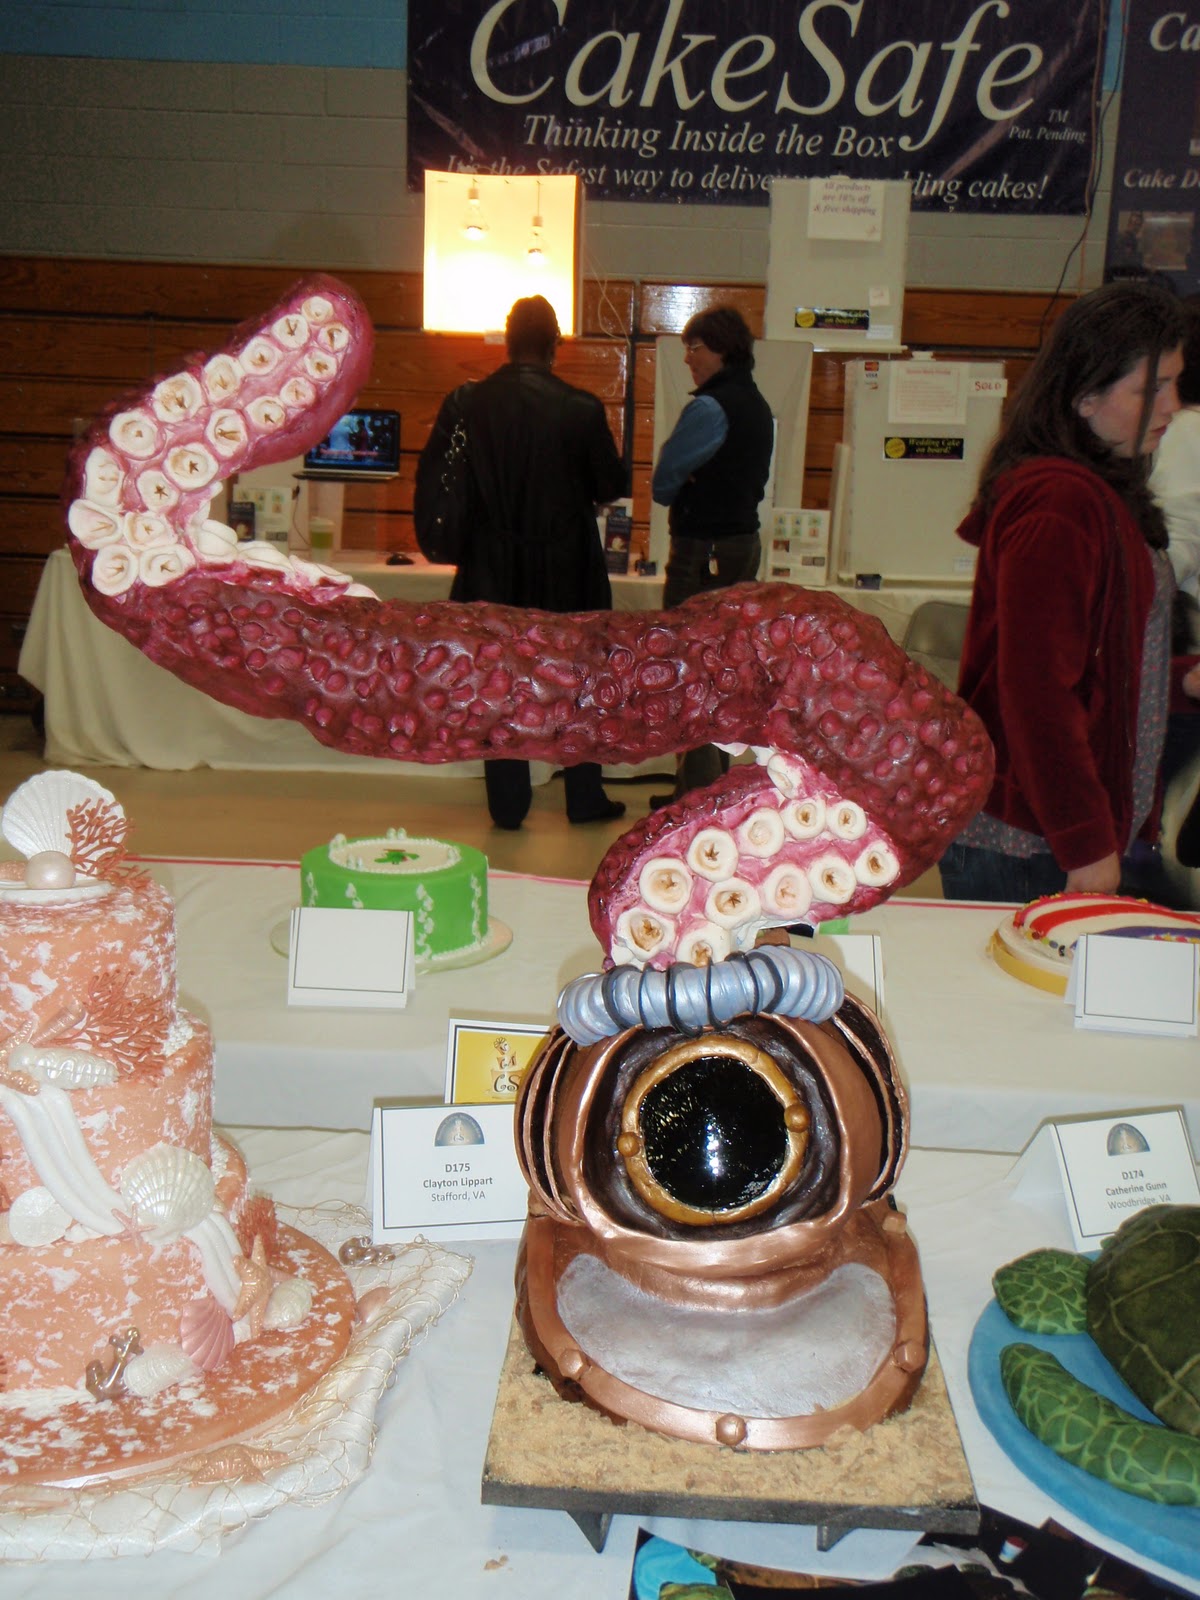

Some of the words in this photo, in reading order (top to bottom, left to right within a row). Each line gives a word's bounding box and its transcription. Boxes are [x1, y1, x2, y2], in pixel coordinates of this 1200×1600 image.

[470, 0, 1043, 151] CakeSafe
[524, 114, 661, 157] Thinking
[669, 120, 766, 153] Inside
[776, 124, 821, 156] the
[831, 126, 894, 158] Box
[1008, 125, 1033, 141] Pat.
[1036, 126, 1087, 143] Pending
[615, 166, 662, 192] way
[671, 168, 693, 189] to
[968, 174, 1050, 200] cakes!
[1123, 167, 1177, 189] Cake
[1179, 169, 1200, 189] D
[444, 1162, 471, 1174] D175
[1121, 1169, 1144, 1181] D174
[422, 1179, 458, 1190] Clayton
[460, 1176, 494, 1189] Lippart
[1105, 1184, 1145, 1197] Catherine
[1145, 1182, 1167, 1191] Gunn
[430, 1191, 471, 1203] Stafford,
[472, 1190, 486, 1200] VA
[1158, 1193, 1171, 1202] VA
